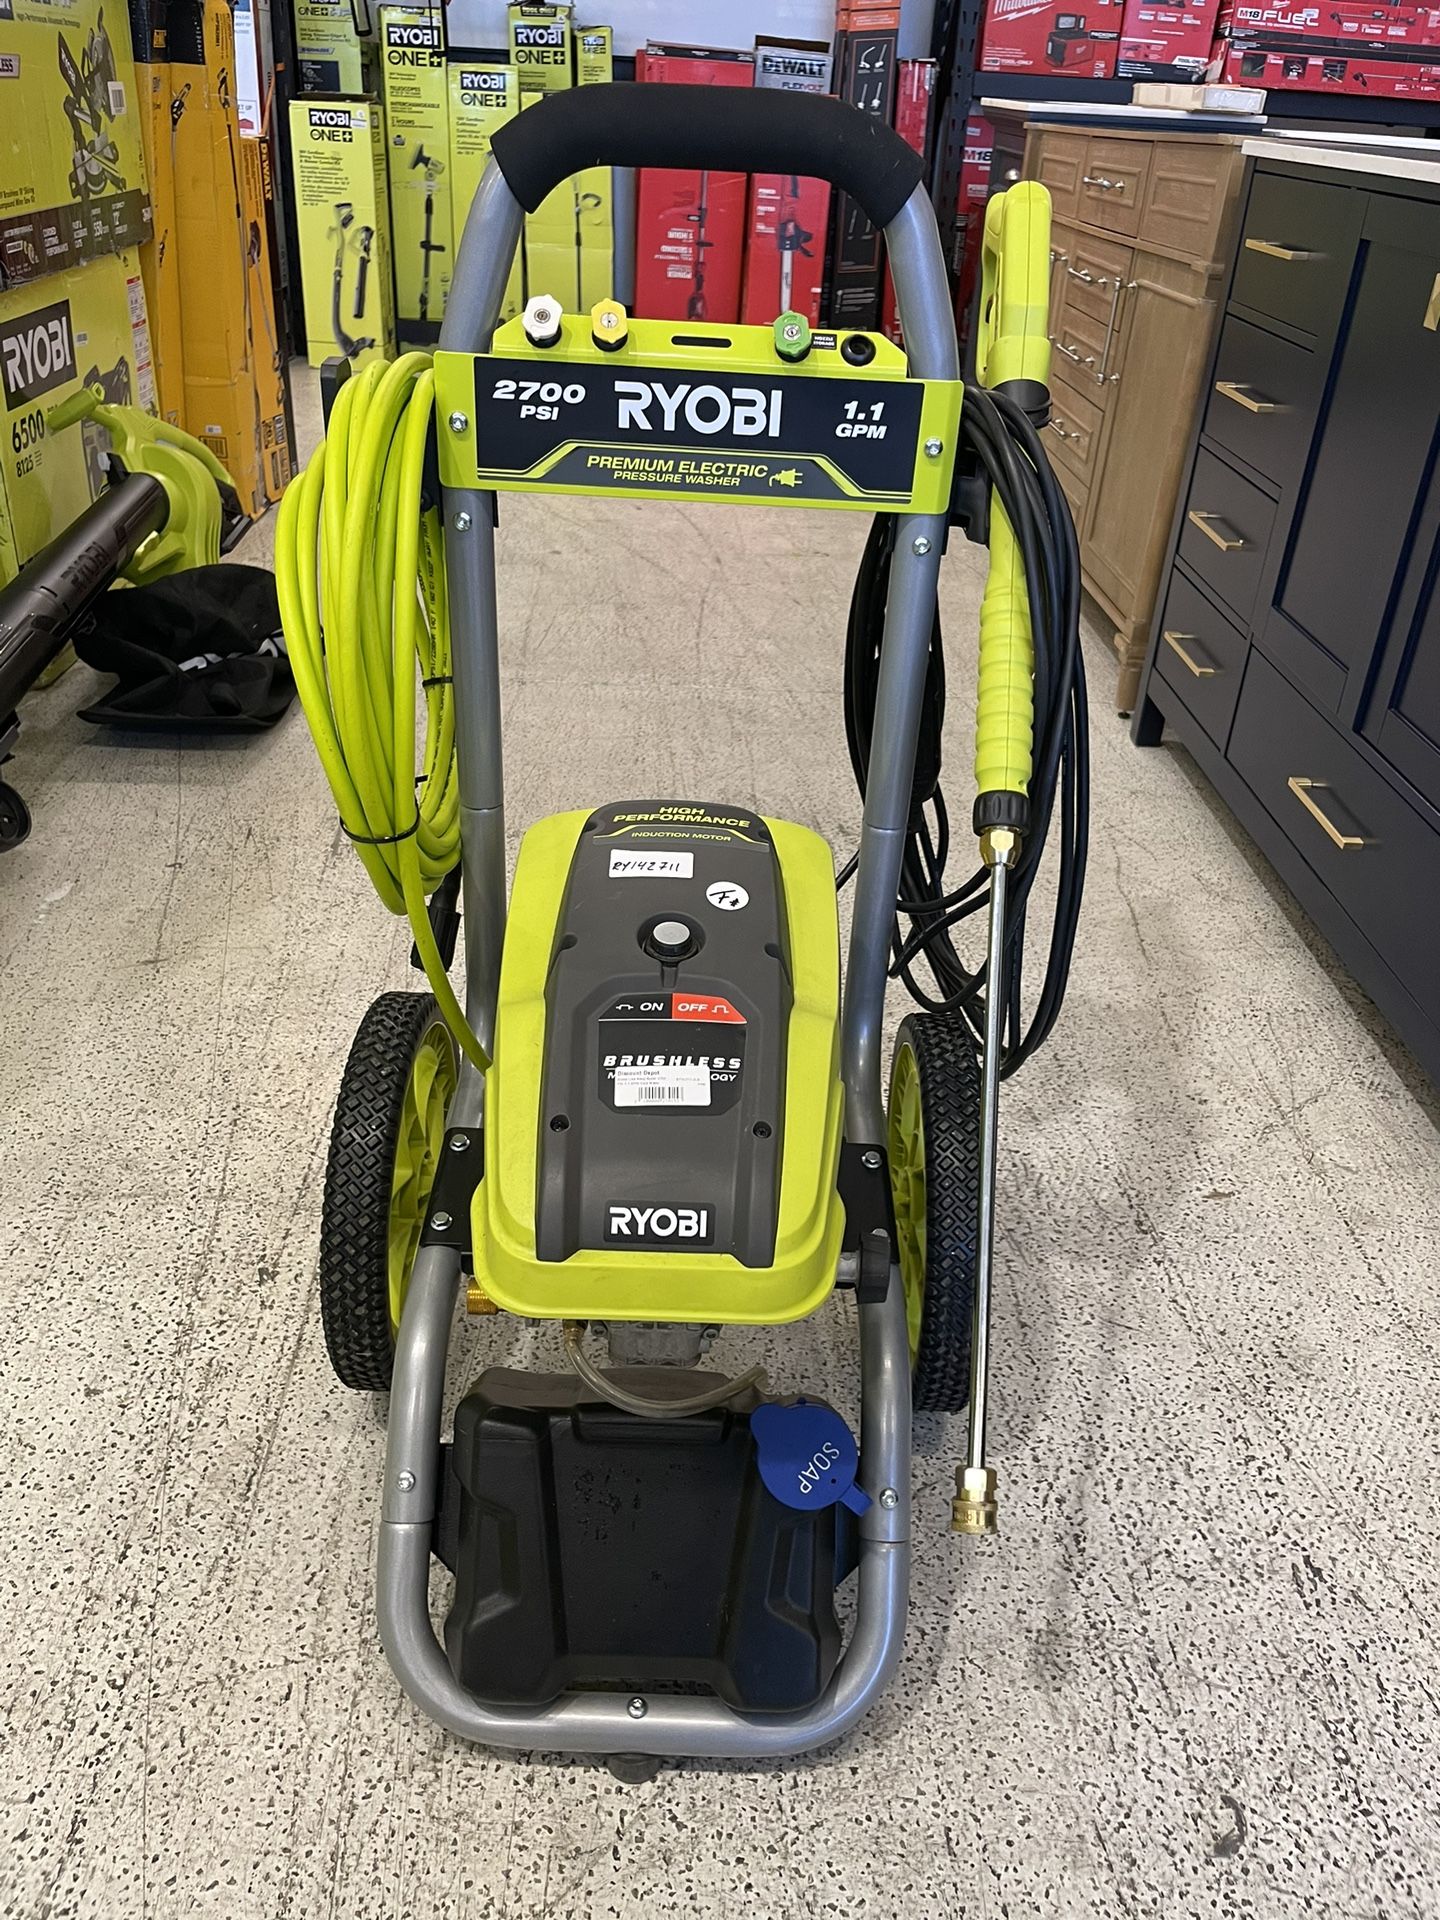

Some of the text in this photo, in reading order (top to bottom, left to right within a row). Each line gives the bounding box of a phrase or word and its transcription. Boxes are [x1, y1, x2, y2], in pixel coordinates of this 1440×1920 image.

[298, 6, 328, 16] ONE+
[1240, 9, 1260, 18] M18
[389, 27, 438, 45] RYOBI
[517, 29, 562, 44] RYOBI
[388, 50, 442, 67] ONE+
[516, 50, 565, 64] ONE+
[462, 74, 503, 88] RYOBI
[782, 82, 824, 92] FLEXVOLT
[461, 93, 506, 107] ONE+
[310, 111, 349, 126] RYOBI
[310, 129, 353, 142] ONE+
[965, 150, 992, 162] M18
[2, 316, 72, 393] RYOBI
[492, 379, 885, 437] 2700 RYOBI 1.1
[520, 404, 888, 439] PSI GPM
[12, 408, 45, 454] 6500
[16, 454, 34, 478] 8125
[587, 455, 769, 478] PREMIUM ELECTRIC
[614, 471, 740, 487] PRESSURE WASHER
[61, 541, 112, 590] RYOBI
[659, 806, 705, 815] HIGH
[613, 814, 751, 828] PERFORMANCE
[640, 1002, 708, 1012] ON OFF
[603, 1055, 741, 1069] BRUSHLESS
[610, 1207, 707, 1237] RYOBI
[798, 1442, 840, 1494] SOAP
